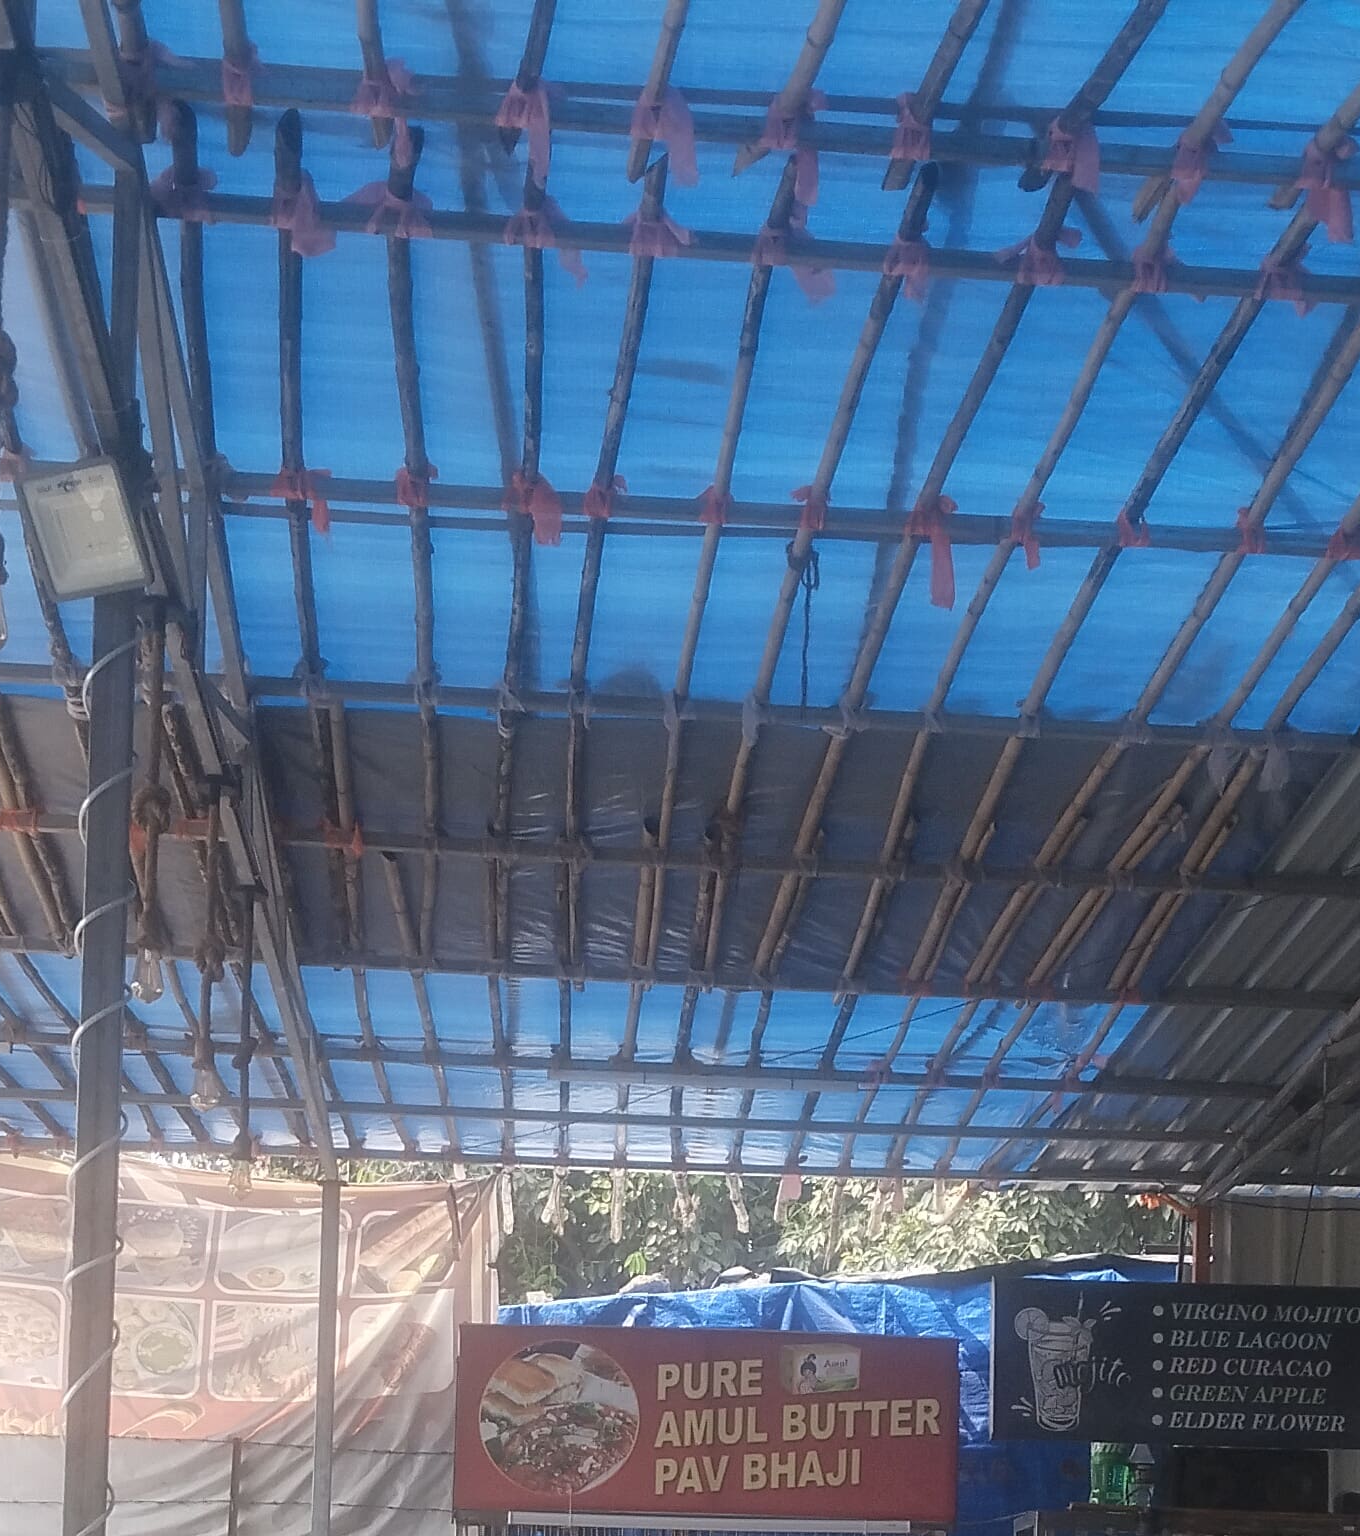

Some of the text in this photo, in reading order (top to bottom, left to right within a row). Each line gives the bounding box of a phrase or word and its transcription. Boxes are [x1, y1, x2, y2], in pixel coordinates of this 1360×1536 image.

[1170, 1302, 1268, 1323] VIRGINO
[1170, 1329, 1332, 1352] BLUE LAGOON
[1170, 1356, 1332, 1379] RED CURACAO
[657, 1359, 764, 1401] PURE
[1170, 1384, 1327, 1405] GREEN APPLE
[653, 1398, 941, 1449] AMUL BUTTER
[1170, 1411, 1346, 1433] ELDER FLOWER
[654, 1448, 862, 1495] PAV BHAJI
